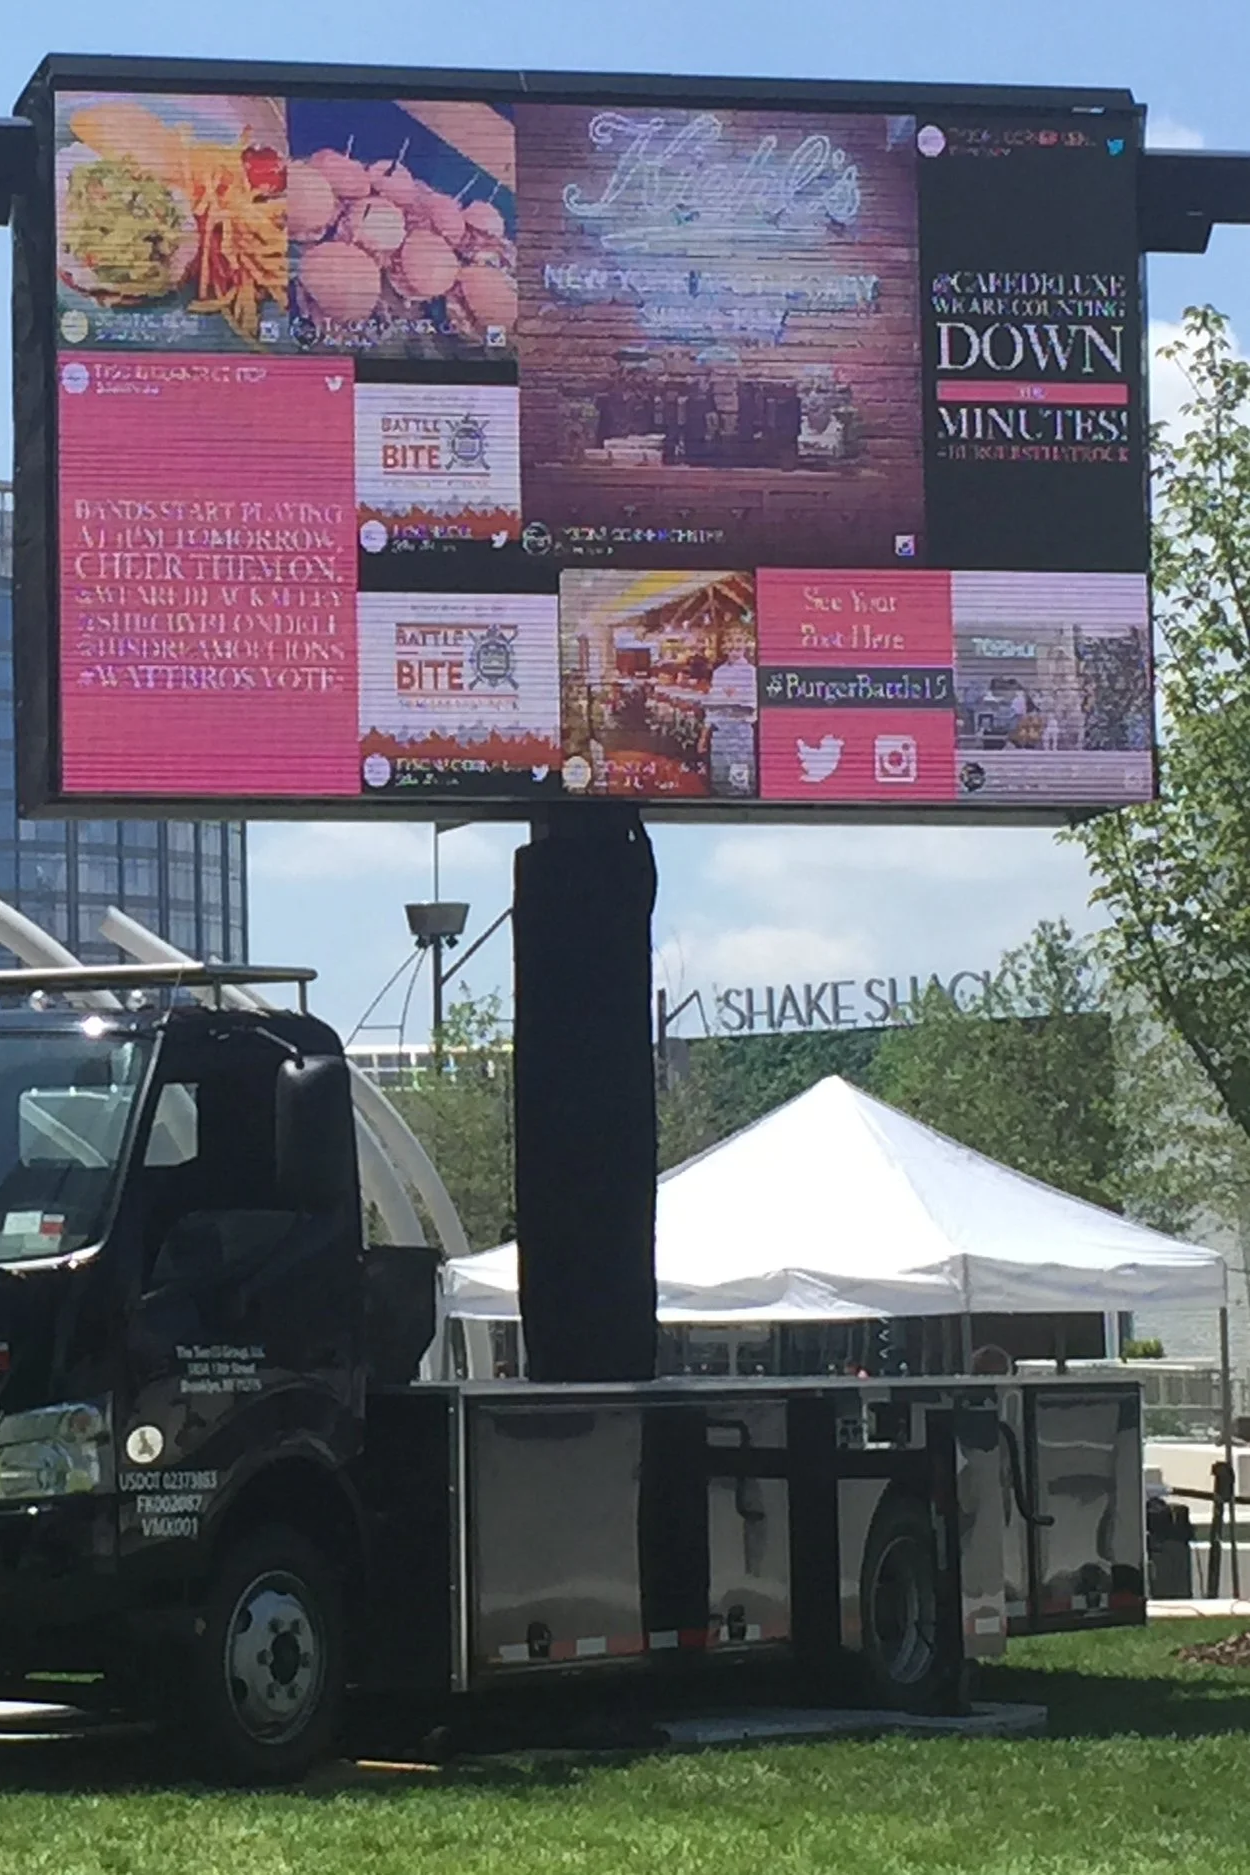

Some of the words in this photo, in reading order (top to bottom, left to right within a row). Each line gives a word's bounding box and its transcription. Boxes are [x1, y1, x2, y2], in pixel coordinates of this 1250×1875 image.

[936, 321, 1125, 373] DOWN
[381, 417, 442, 433] BATTLE
[937, 406, 1128, 442] MINUTES!
[382, 444, 442, 469] BITE
[160, 500, 236, 522] START
[75, 552, 185, 580] CHEER
[189, 553, 284, 583] THEM
[804, 587, 843, 611] See
[396, 629, 464, 647] BATTLE
[397, 660, 464, 690] BITE
[766, 673, 947, 705] #BurgerBattle15
[721, 980, 858, 1031] SHAKE
[119, 1471, 160, 1490] USDOT
